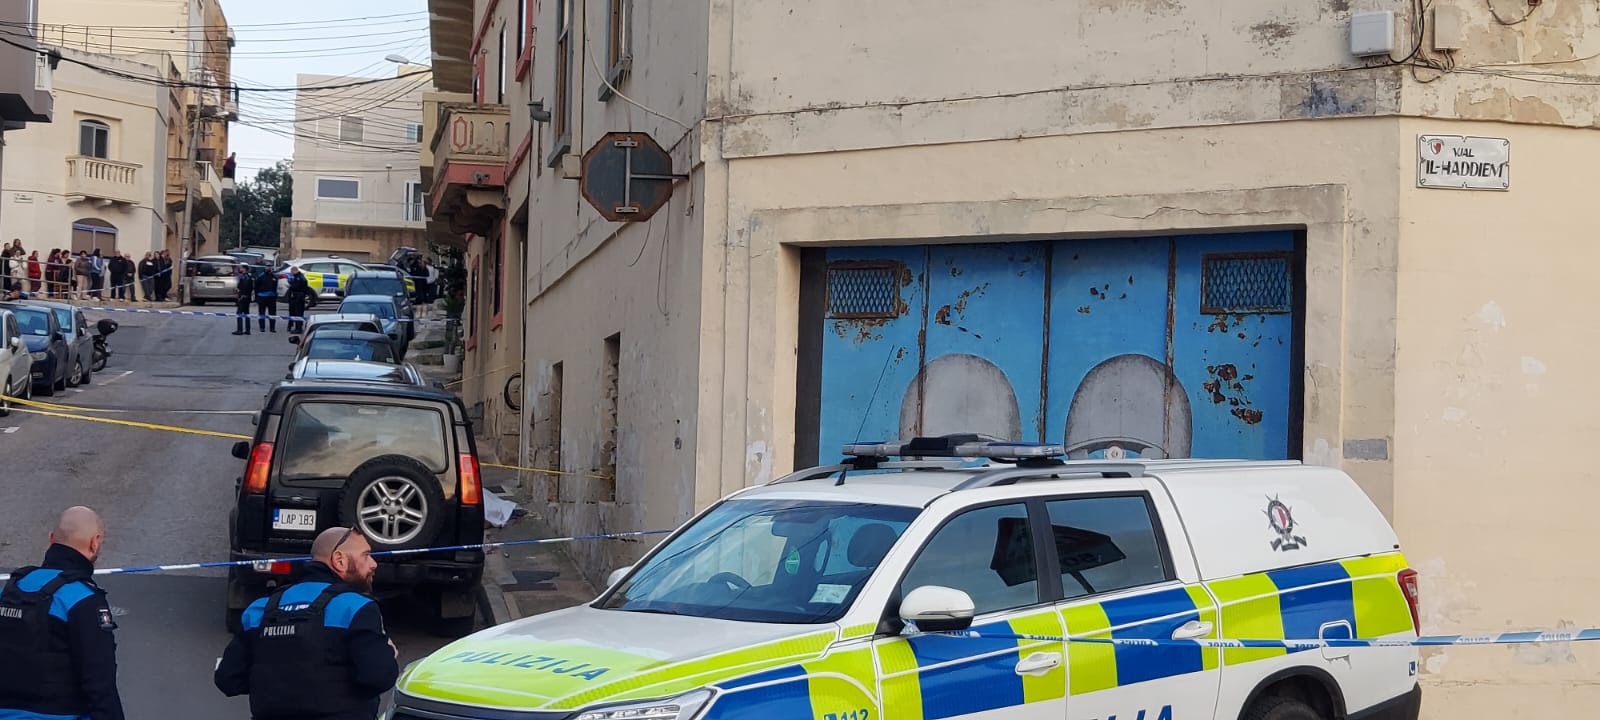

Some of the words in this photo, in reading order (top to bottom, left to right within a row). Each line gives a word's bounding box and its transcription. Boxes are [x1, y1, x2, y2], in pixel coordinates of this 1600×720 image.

[1453, 147, 1475, 158] VJAL
[1425, 160, 1507, 178] IL-HADDIEM
[281, 514, 297, 525] LAP
[298, 514, 314, 526] 183
[263, 625, 296, 637] PULIZIJA
[441, 651, 611, 681] PULIZIJA
